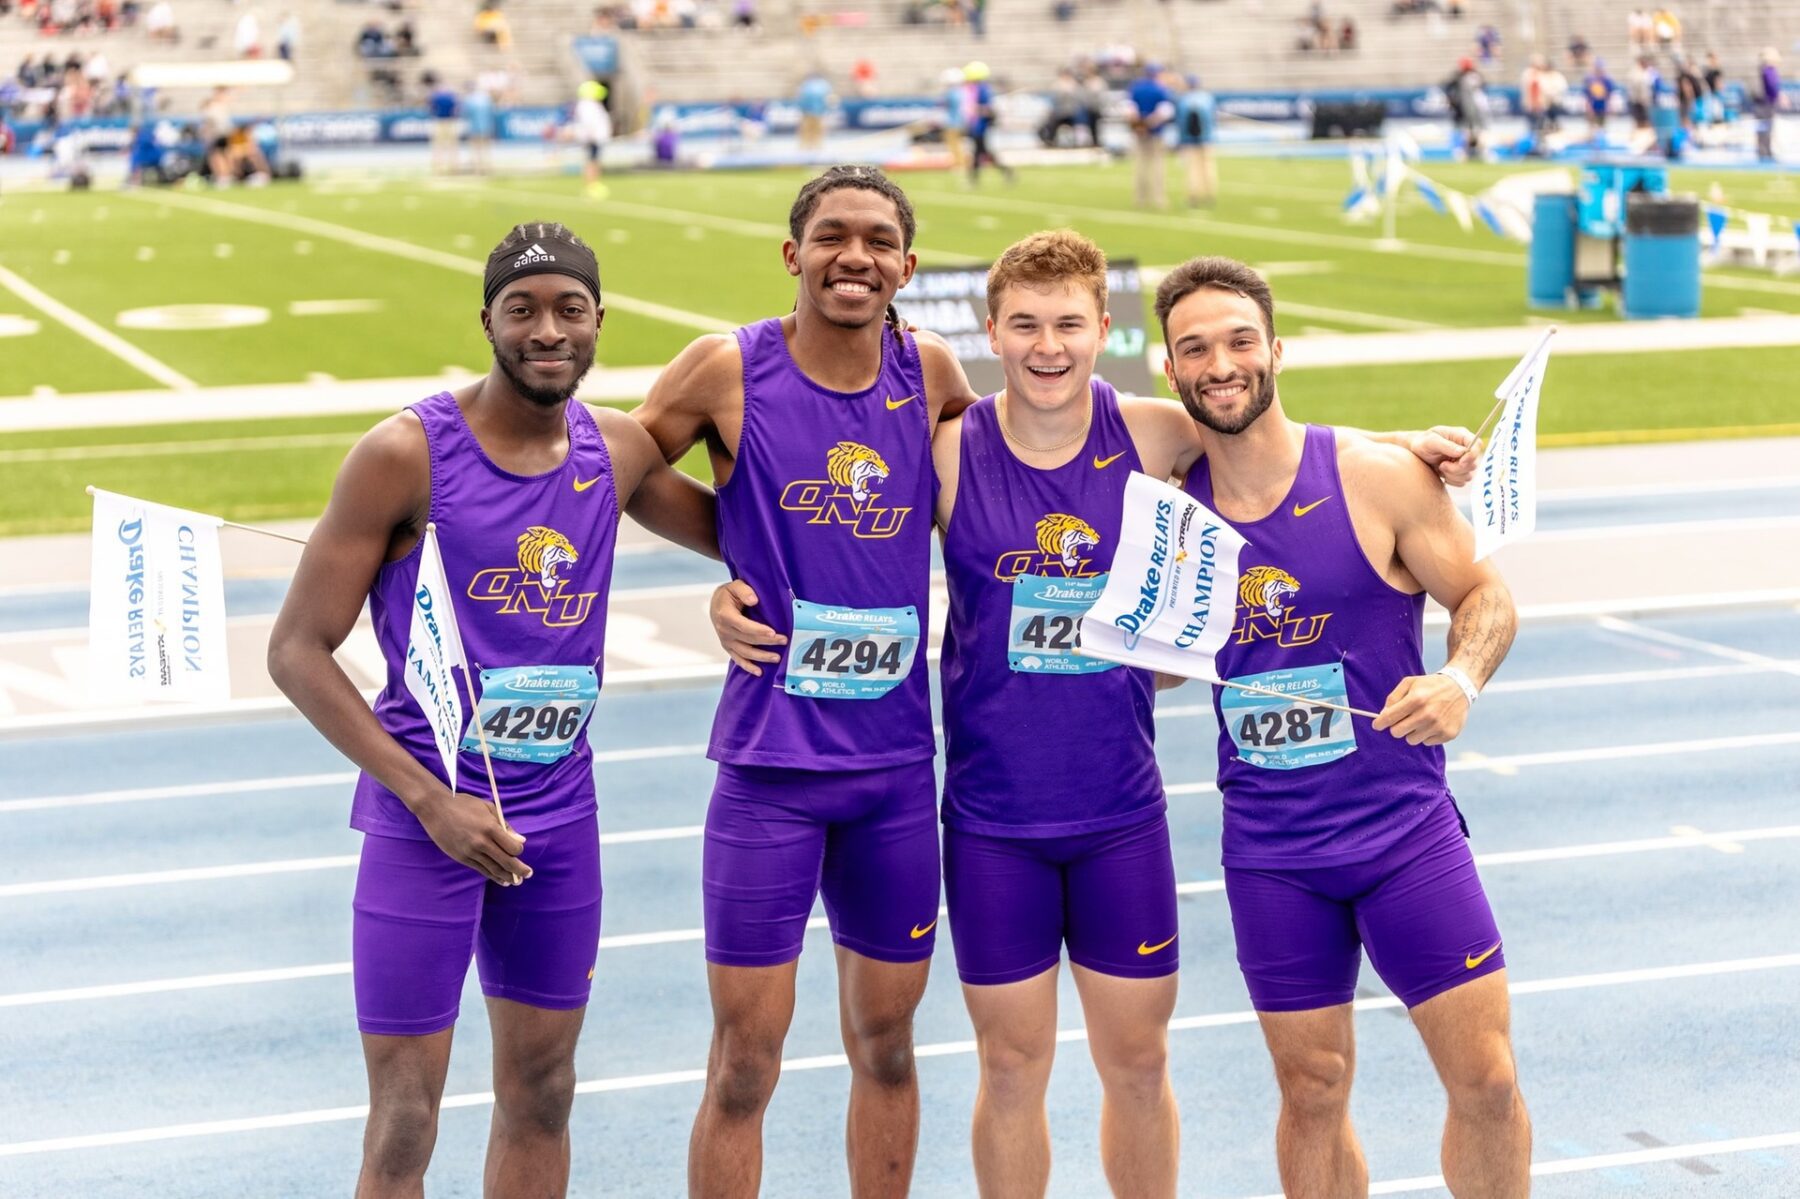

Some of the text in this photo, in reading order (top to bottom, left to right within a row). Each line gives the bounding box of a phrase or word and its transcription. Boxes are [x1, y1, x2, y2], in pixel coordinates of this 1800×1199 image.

[514, 254, 556, 268] adidas
[1509, 455, 1519, 521] RELAYS
[779, 480, 913, 539] ONU
[1178, 503, 1195, 550] XTREAM
[1115, 500, 1172, 635] Drake RELAYS
[1174, 522, 1221, 648] CHAMPION
[467, 567, 599, 627] ONU
[1044, 584, 1084, 599] Drake
[1169, 573, 1180, 609] PRESENTED
[825, 609, 863, 622] Drake
[864, 614, 894, 623] RELAYS
[1232, 605, 1334, 648] NU
[802, 638, 902, 675] 4294
[514, 672, 577, 688] Drake RELAYS
[821, 681, 846, 689] WORLD
[1286, 679, 1318, 692] RELAYS
[483, 706, 582, 741] 4296
[1240, 705, 1335, 747] 4287
